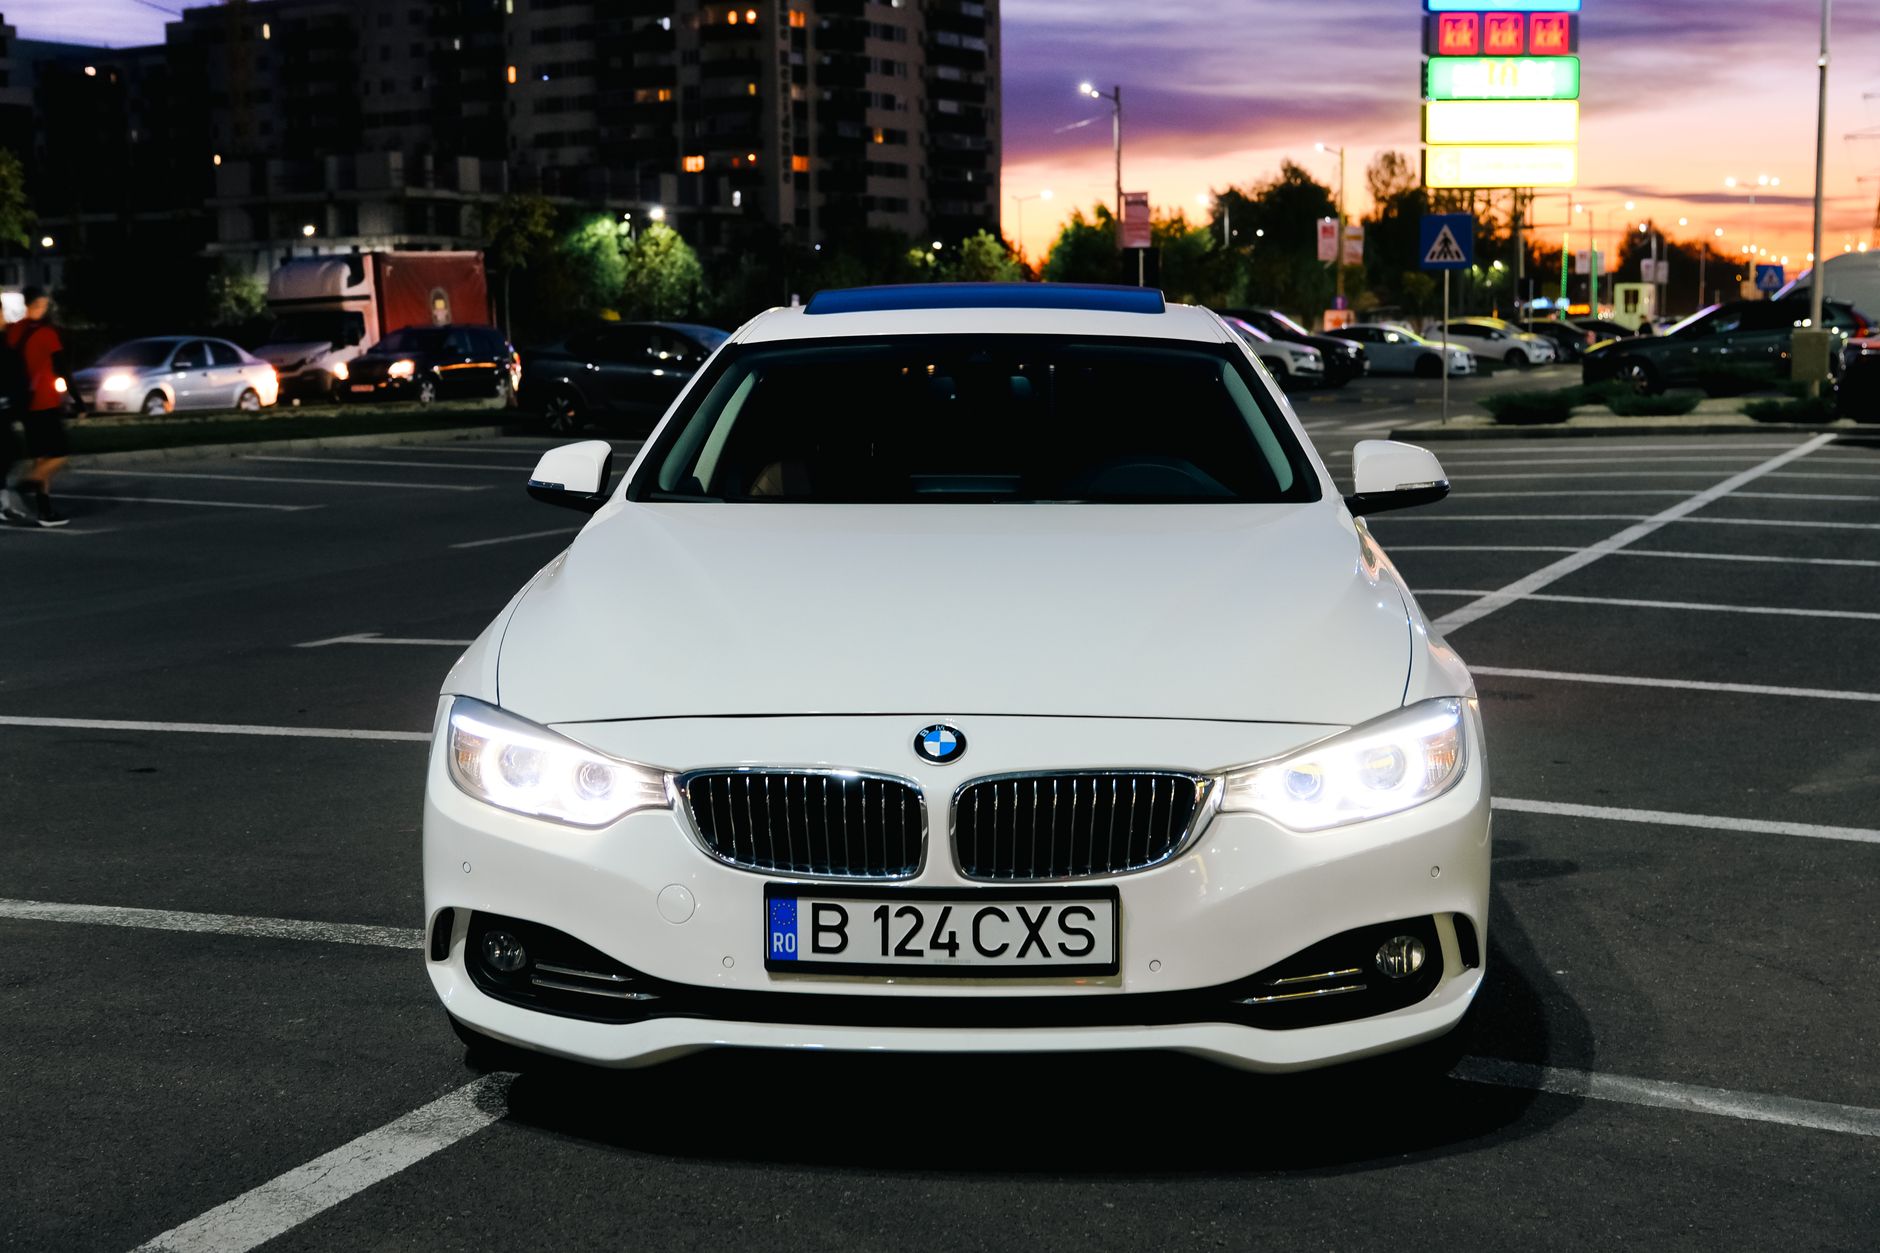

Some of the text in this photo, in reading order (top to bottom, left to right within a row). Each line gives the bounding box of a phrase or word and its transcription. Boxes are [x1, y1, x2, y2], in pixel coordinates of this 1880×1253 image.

[773, 933, 796, 953] RO
[812, 903, 1096, 958] B 124 CXS
